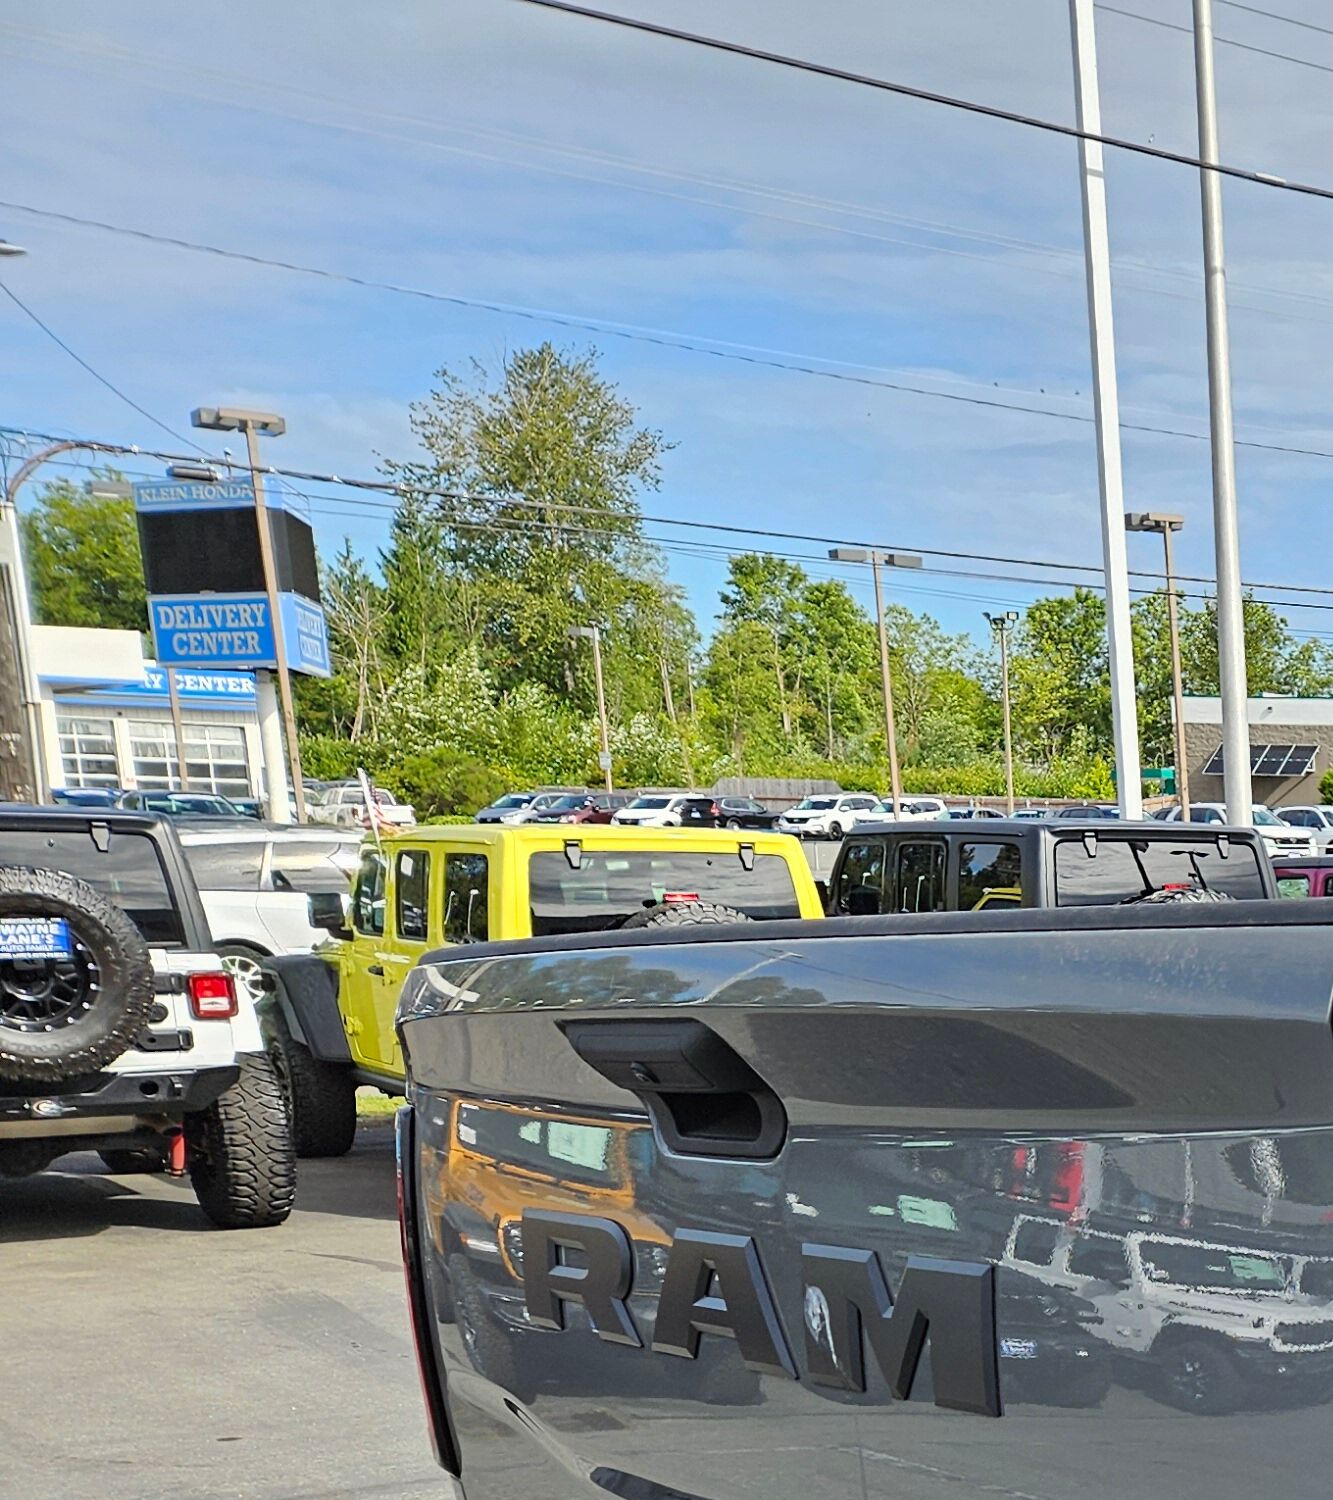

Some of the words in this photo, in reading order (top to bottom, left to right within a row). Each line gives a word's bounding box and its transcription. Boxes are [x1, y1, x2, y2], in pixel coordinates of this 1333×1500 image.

[140, 486, 188, 502] KLEIN
[191, 483, 255, 500] HONDA
[157, 603, 266, 629] DELIVERY
[172, 630, 262, 656] CENTER
[175, 674, 256, 693] CENTER
[520, 1207, 1004, 1418] RAM
